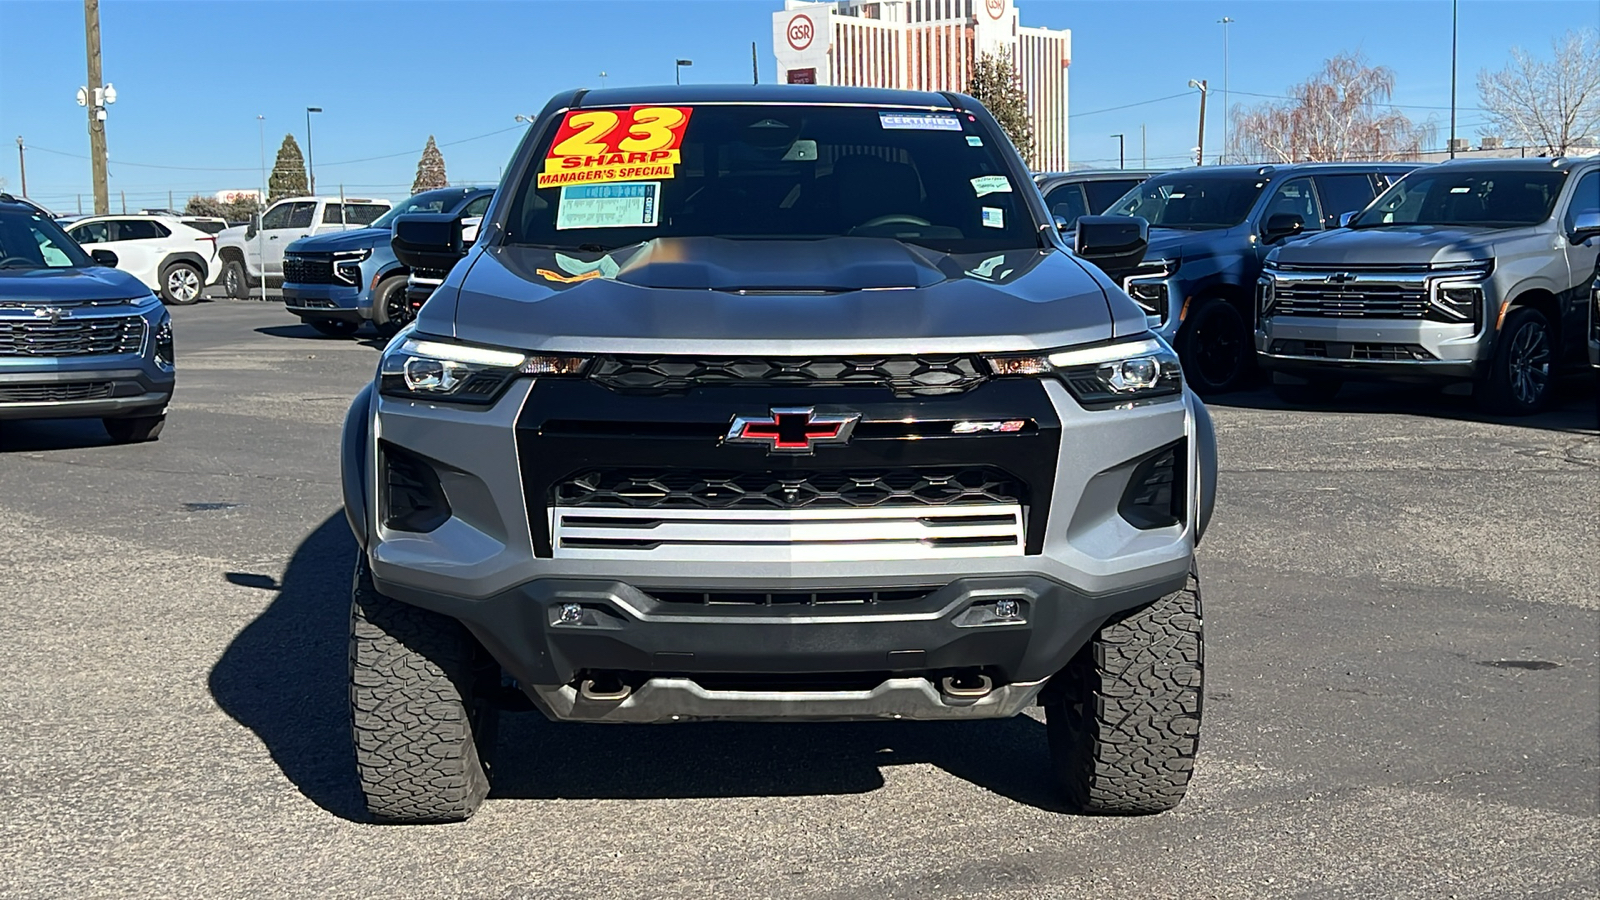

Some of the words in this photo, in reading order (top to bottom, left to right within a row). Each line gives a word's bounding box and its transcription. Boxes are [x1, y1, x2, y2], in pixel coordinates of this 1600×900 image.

[790, 26, 810, 40] GSR
[884, 117, 957, 126] CERTIFIED
[553, 107, 686, 155] 23
[561, 151, 671, 169] SHARP
[539, 170, 618, 185] MANAGER'S
[619, 166, 671, 178] SPECIAL
